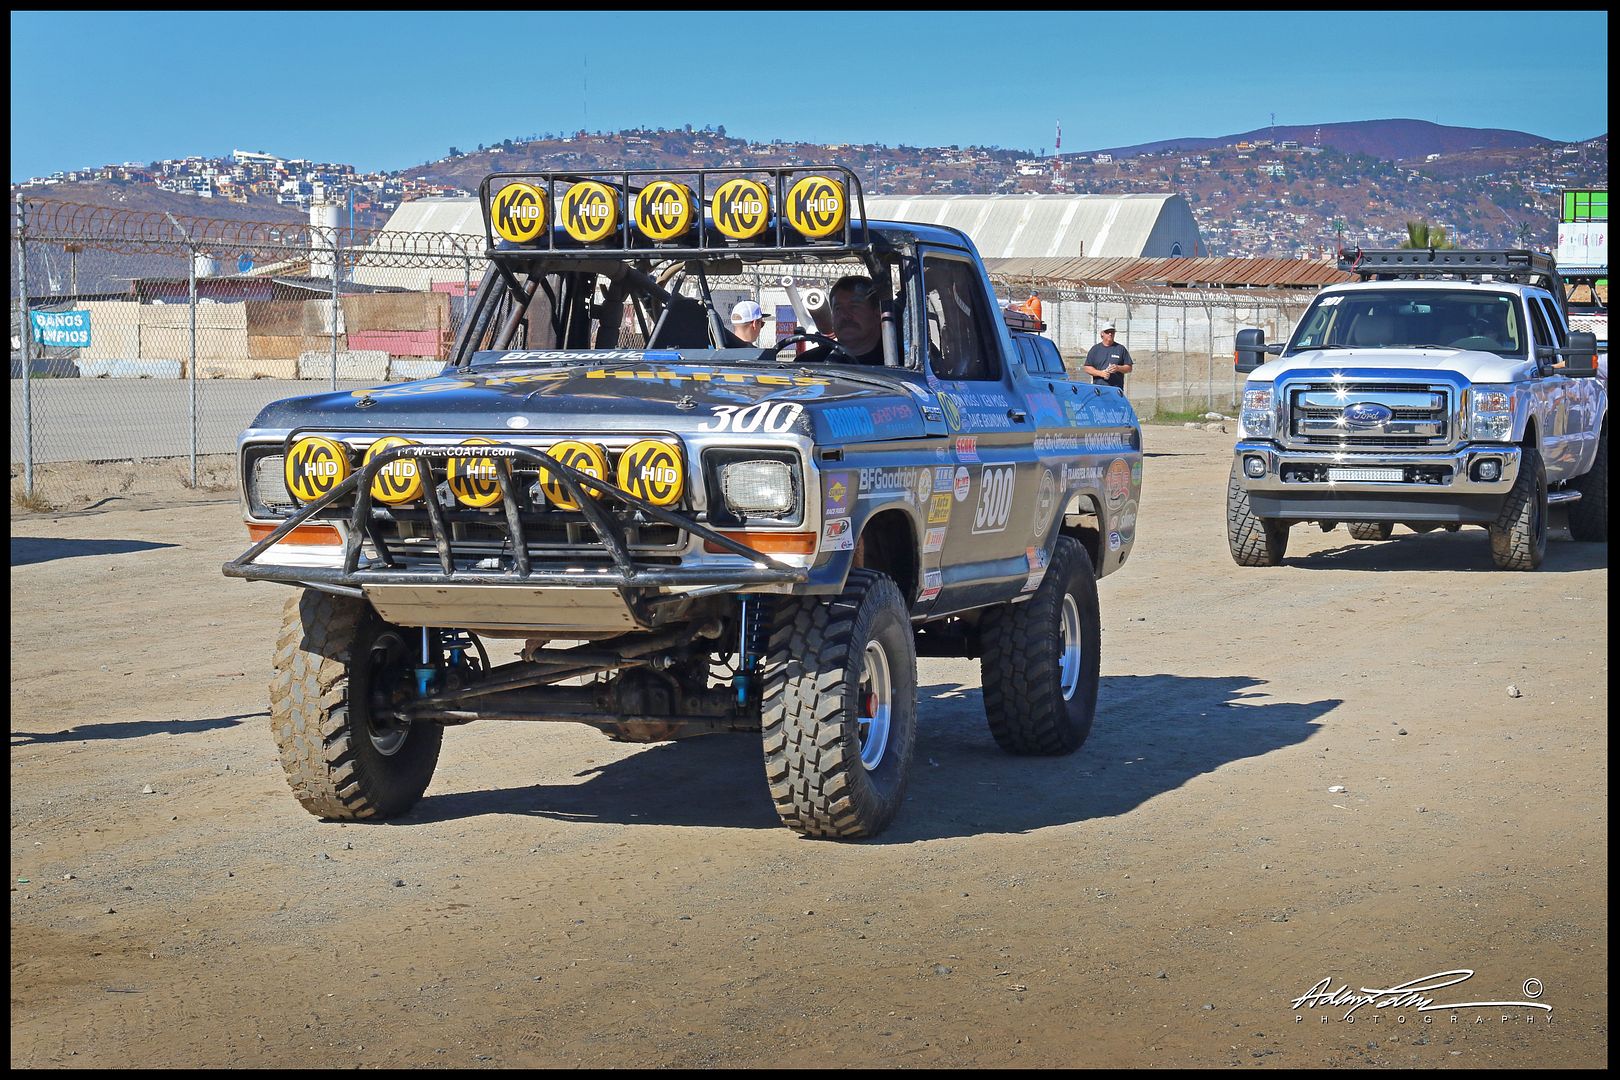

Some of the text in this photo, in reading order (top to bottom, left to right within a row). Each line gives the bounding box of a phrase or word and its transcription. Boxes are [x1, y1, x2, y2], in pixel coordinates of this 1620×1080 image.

[499, 189, 537, 236] KC
[508, 205, 540, 219] HID
[568, 187, 606, 235] KC
[578, 203, 610, 217] HID
[641, 186, 680, 233] KC
[651, 202, 683, 216] HID
[719, 184, 759, 232] KC
[730, 200, 763, 215] HID
[795, 182, 835, 231] KC
[806, 198, 839, 213] HID
[500, 351, 646, 361] BFGoodric
[697, 402, 804, 433] 300
[822, 406, 874, 438] BRONCO
[293, 443, 335, 497] KC
[304, 462, 339, 477] HID
[380, 462, 417, 477] HID
[627, 447, 675, 501] KC
[640, 465, 677, 484] HID
[858, 468, 918, 490] BFGoodrich
[976, 467, 1014, 528] 300
